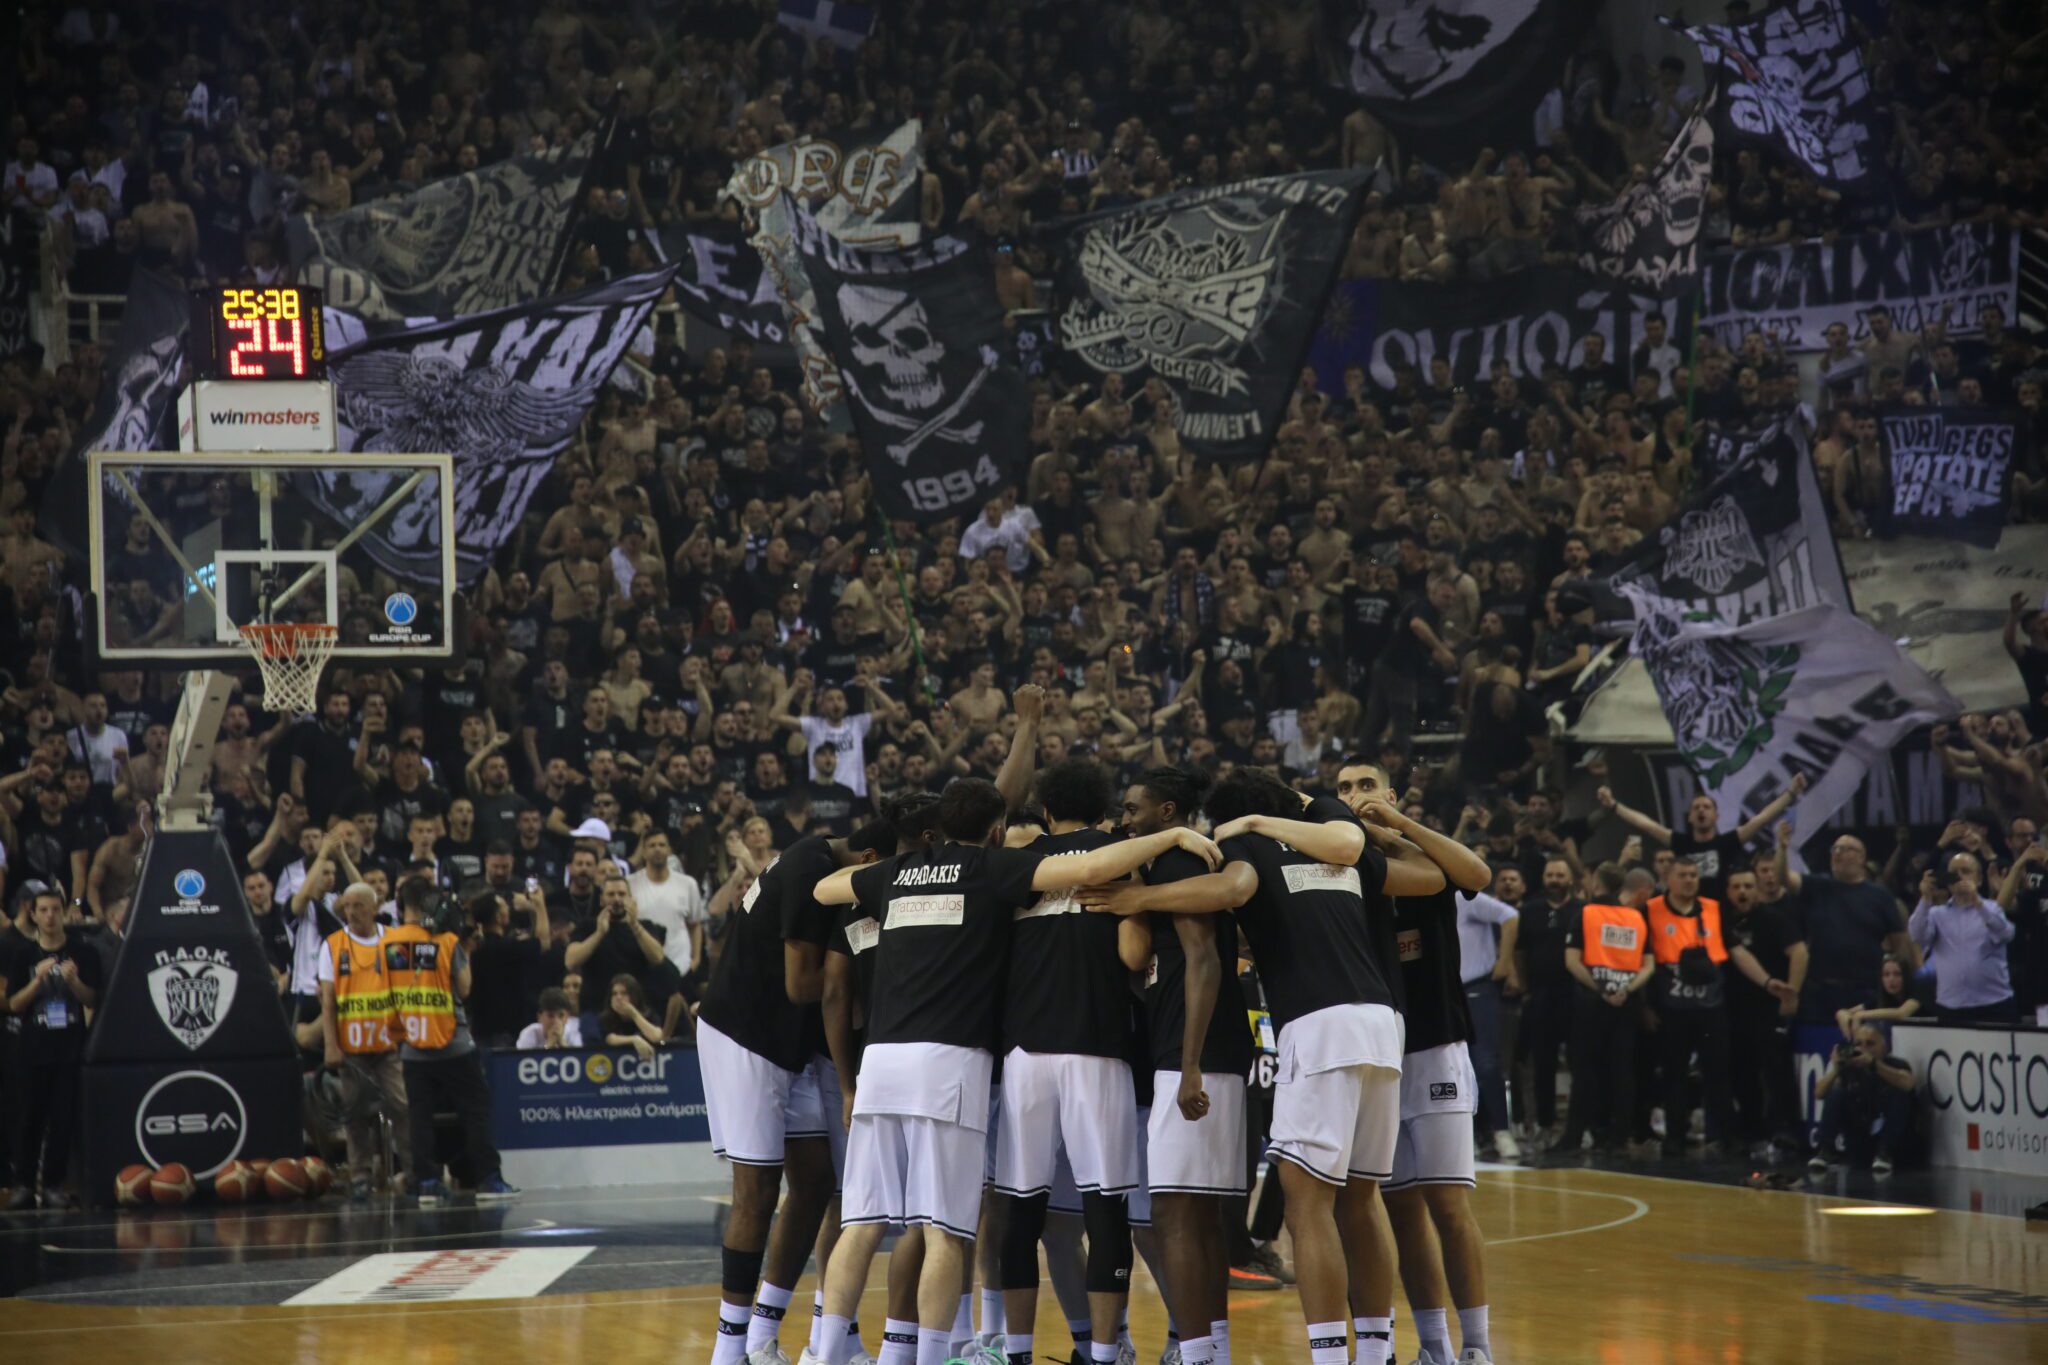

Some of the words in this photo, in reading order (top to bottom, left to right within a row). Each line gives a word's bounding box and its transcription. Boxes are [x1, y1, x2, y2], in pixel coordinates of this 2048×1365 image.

[222, 289, 300, 320] 25:38
[228, 318, 304, 376] 24
[210, 409, 320, 425] winmasters
[902, 453, 1000, 512] 1994
[369, 634, 409, 642] EUROPE
[411, 634, 432, 642] CUP
[893, 864, 961, 886] PAPADAKIS
[161, 905, 199, 915] EUROPE
[201, 904, 220, 914] CUP
[1399, 938, 1420, 954] ers
[154, 945, 232, 967] Π.Α.Ο.Κ.
[518, 1055, 581, 1084] eco
[617, 1053, 672, 1081] car
[600, 1085, 632, 1096] electric
[634, 1083, 668, 1094] vehicles
[520, 1106, 561, 1123] 100%
[565, 1103, 642, 1122] Ηλεκτρικά
[145, 1111, 238, 1135] GSA
[753, 1306, 777, 1319] GSA
[719, 1322, 733, 1334] SA
[1311, 1338, 1343, 1349] GSA
